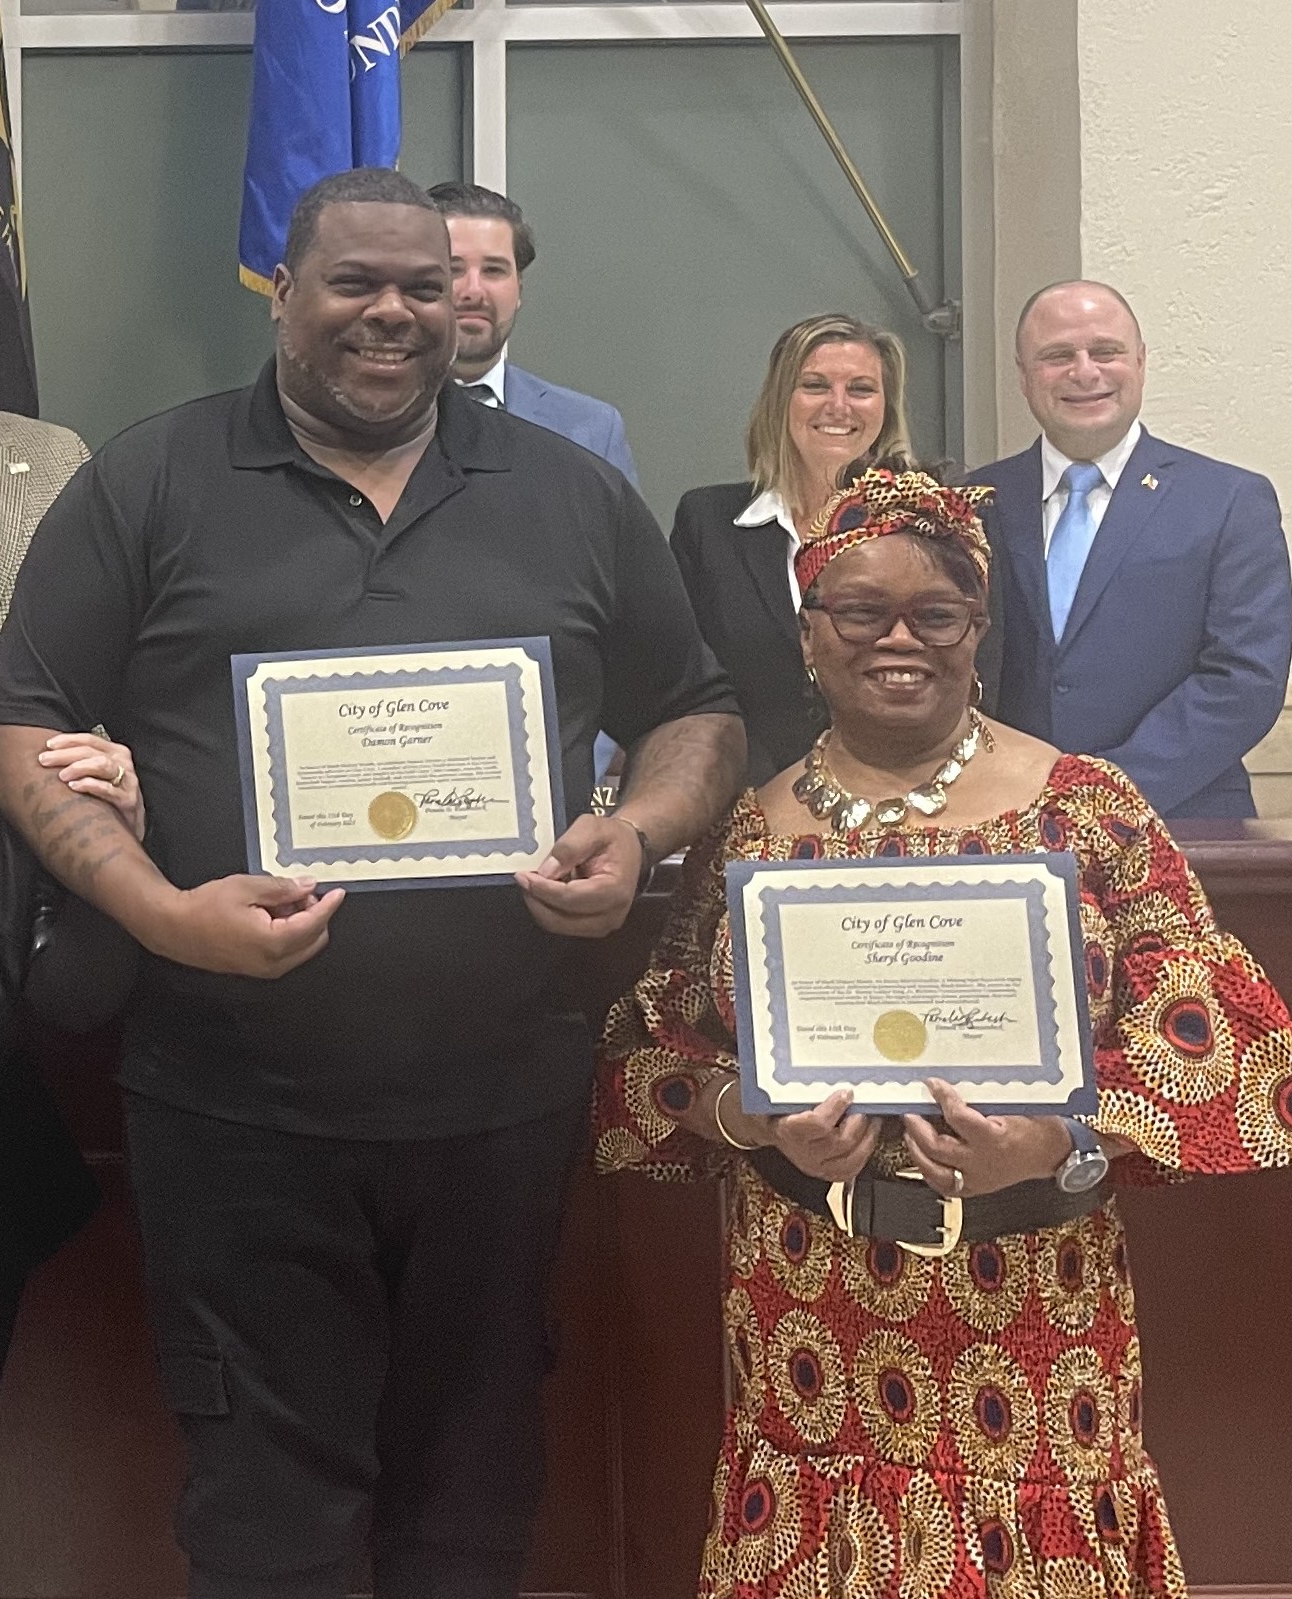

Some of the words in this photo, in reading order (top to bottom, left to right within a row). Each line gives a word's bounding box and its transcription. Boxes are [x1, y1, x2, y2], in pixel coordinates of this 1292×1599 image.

[339, 704, 366, 719] City
[369, 700, 384, 718] of
[386, 699, 415, 717] Glen
[419, 700, 450, 712] Cove
[388, 723, 398, 734] of
[361, 737, 396, 748] Damon
[399, 735, 433, 748] Garner
[841, 916, 871, 933] City
[873, 914, 892, 933] of
[893, 914, 925, 934] Glen
[929, 915, 963, 929] Cove
[895, 939, 906, 952] of
[864, 952, 898, 966] Sheryl
[900, 952, 944, 965] Goodine
